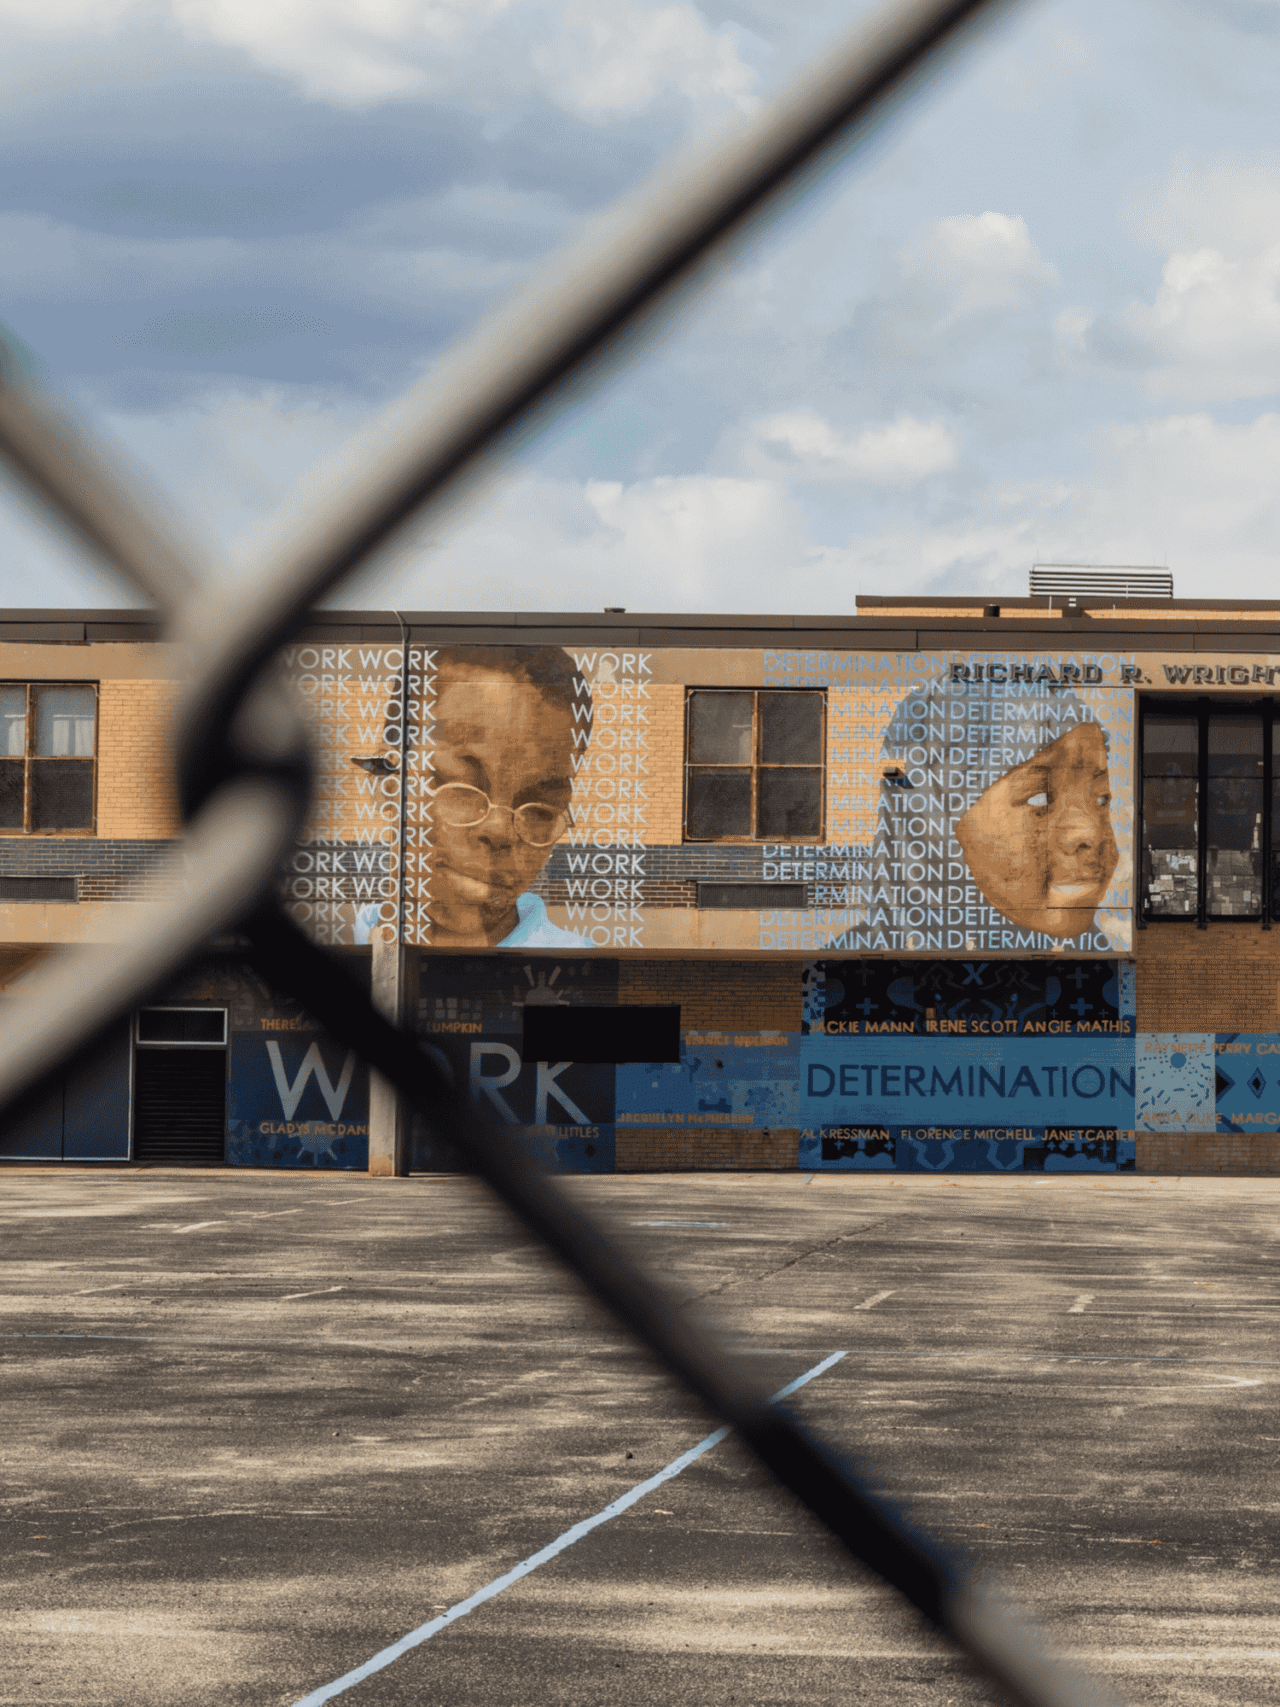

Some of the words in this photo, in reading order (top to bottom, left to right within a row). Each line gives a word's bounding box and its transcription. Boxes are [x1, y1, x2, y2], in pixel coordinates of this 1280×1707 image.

[358, 648, 439, 671] WORK
[573, 652, 652, 674] WORK
[764, 652, 947, 673] DETERMINATION
[949, 662, 1103, 684] RICHARD
[1119, 664, 1153, 685] R.
[297, 674, 353, 696] ORK
[358, 674, 438, 696] WORK
[572, 677, 651, 699] WORK
[357, 699, 437, 721] WORK
[571, 702, 651, 724] WORK
[950, 700, 1133, 725] DETERMINATION
[356, 724, 437, 746] WORK
[570, 727, 651, 750] WORK
[382, 750, 436, 771] ORK
[569, 752, 650, 774] WORK
[355, 775, 437, 797] WORK
[569, 777, 649, 799] WORK
[354, 800, 434, 822] WORK
[568, 802, 648, 824] WORK
[353, 825, 433, 847] WORK
[567, 827, 647, 849] WORK
[292, 851, 348, 873] ORK
[353, 851, 433, 873] WORK
[566, 852, 646, 875] WORK
[762, 861, 944, 882] DETERMINATION
[291, 876, 348, 899] ORK
[352, 876, 432, 898] WORK
[565, 877, 645, 900] WORK
[565, 900, 644, 921] WORK
[378, 922, 432, 945] ORK
[808, 1020, 860, 1034] JACKIE
[864, 1020, 915, 1034] MANN
[925, 1019, 968, 1033] IRENE
[970, 1020, 1018, 1033] SCOTT
[1023, 1019, 1072, 1034] ANGIE
[1076, 1019, 1131, 1033] MATHIS
[1210, 1043, 1252, 1055] PERRY
[265, 1040, 593, 1125] WRK
[807, 1063, 1136, 1098] DETERMINATION
[259, 1121, 311, 1135] GLADYS
[1186, 1112, 1223, 1125] DUKE
[800, 1128, 816, 1139] AL
[819, 1128, 890, 1140] KRESSMAN
[901, 1129, 971, 1141] FLORENCE
[974, 1129, 1036, 1141] MITCHELL
[1041, 1129, 1083, 1141] JANET
[1085, 1129, 1135, 1141] CARTER
